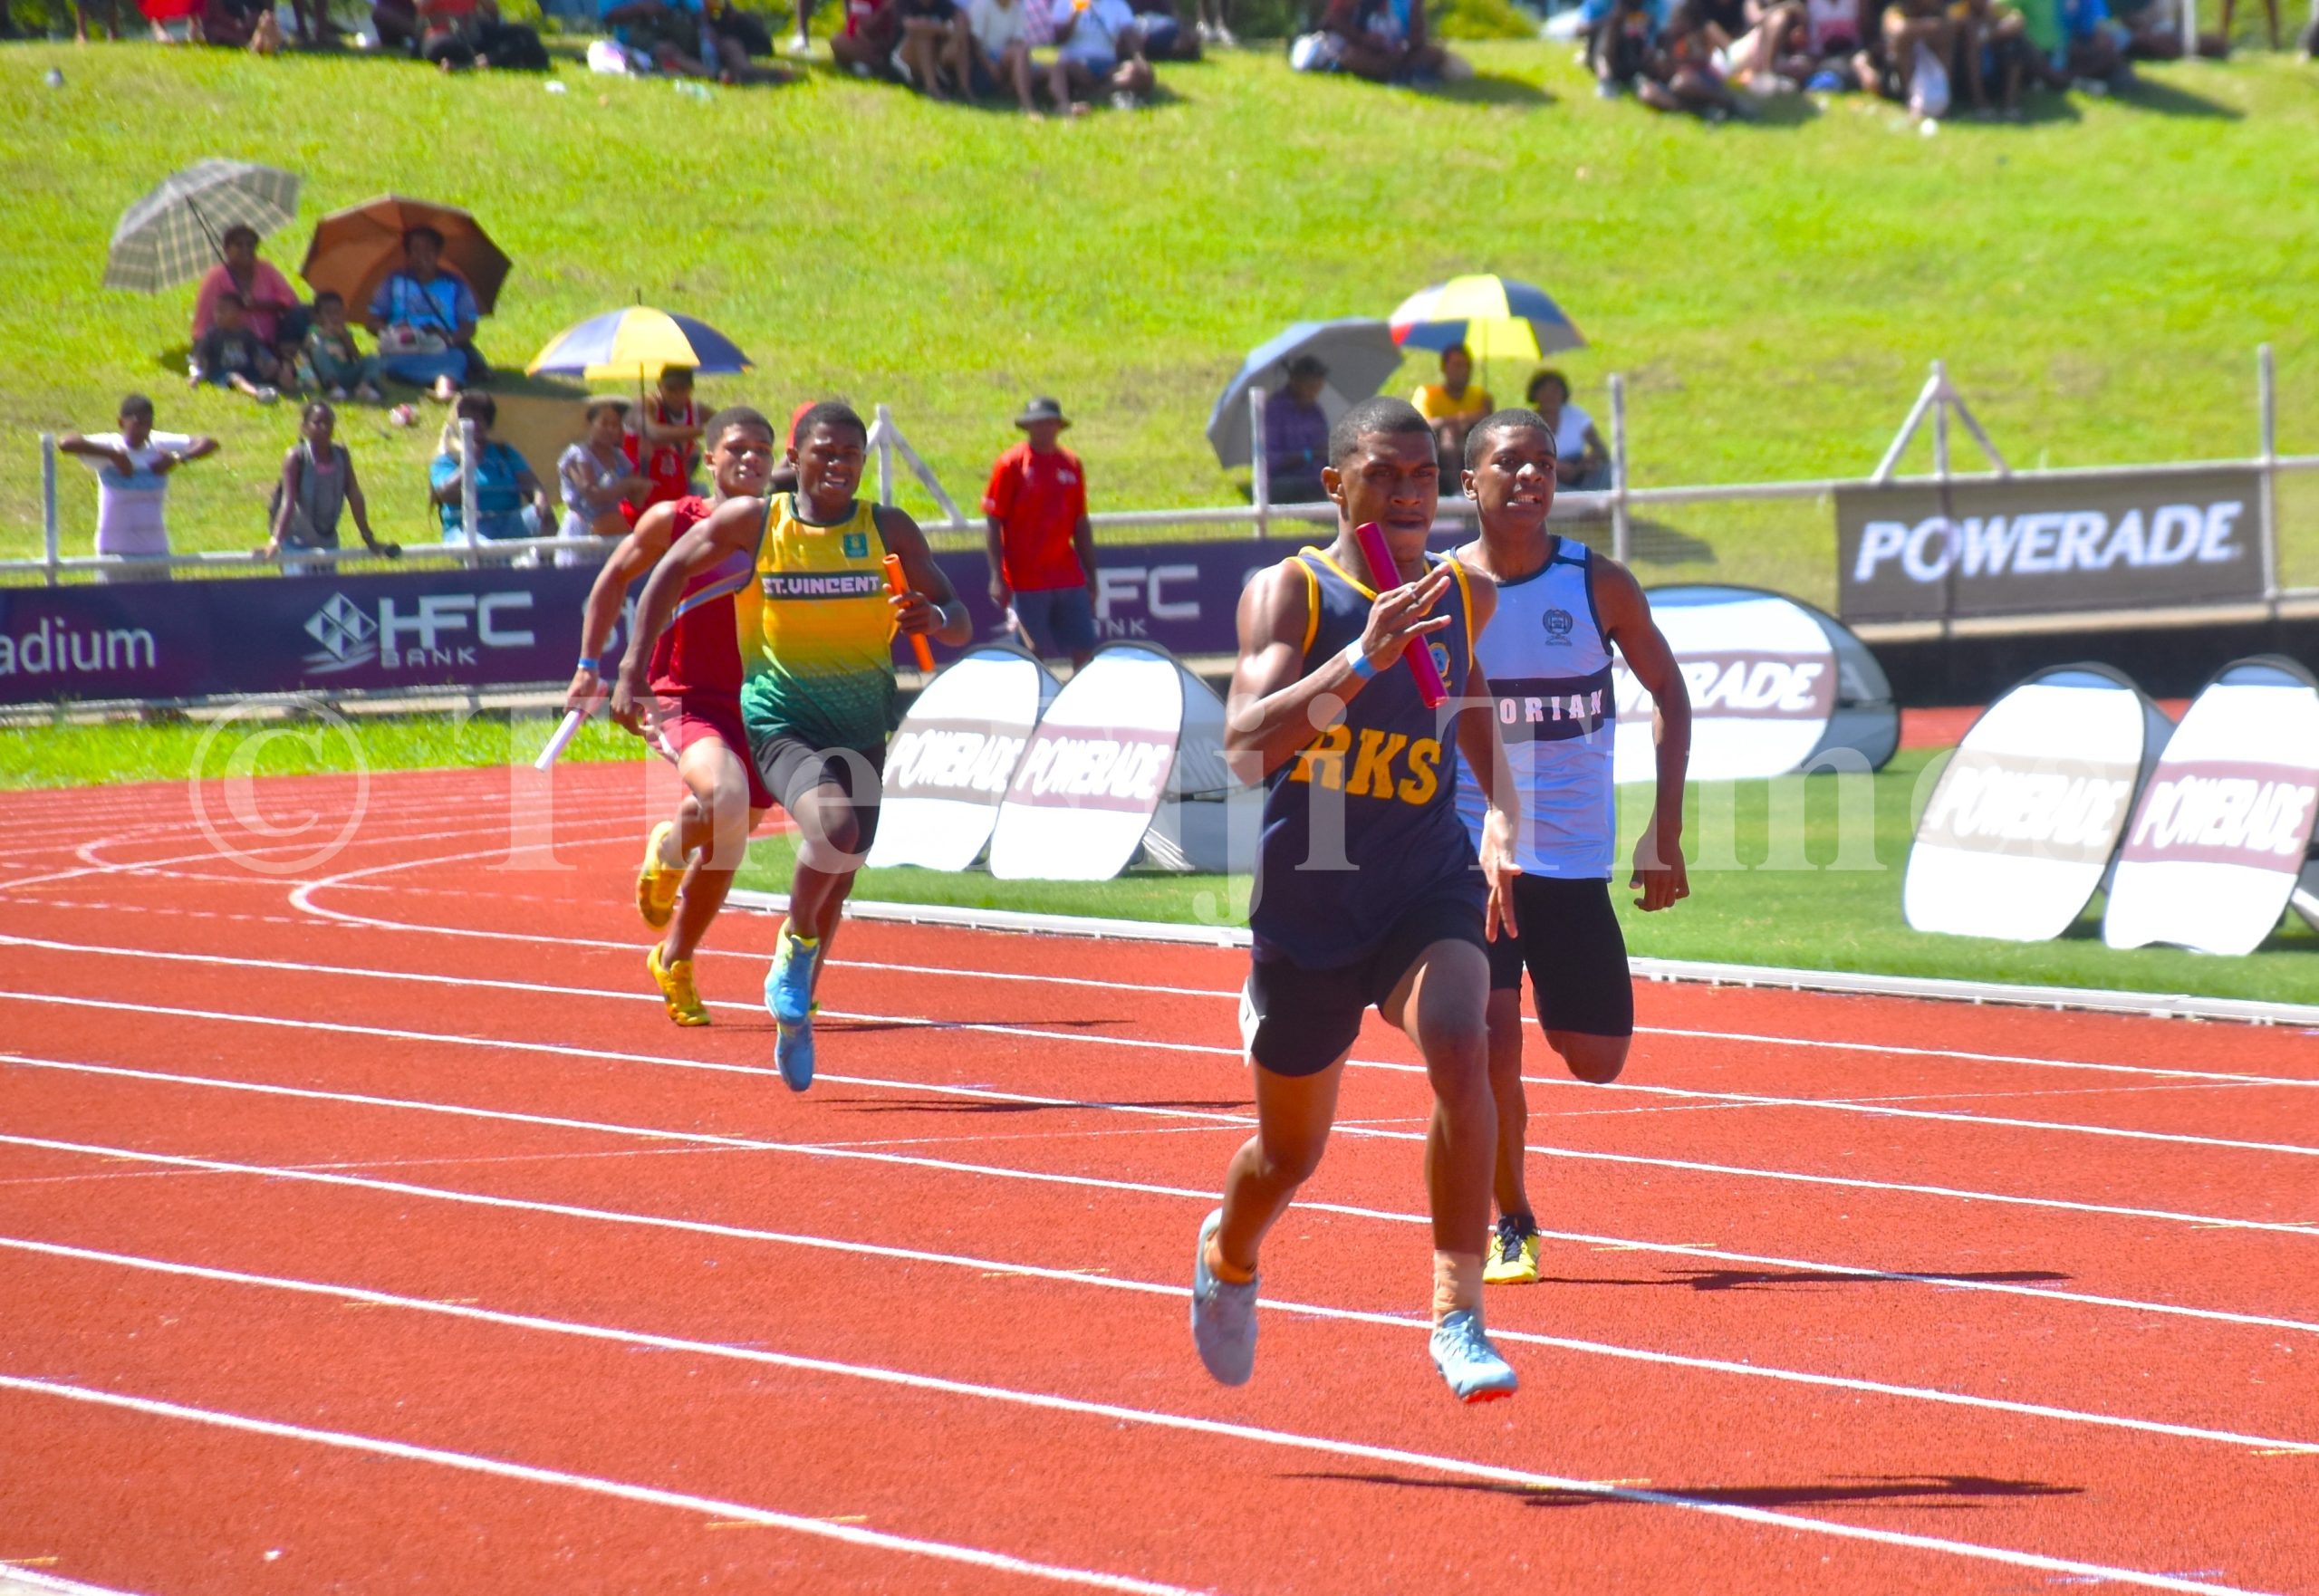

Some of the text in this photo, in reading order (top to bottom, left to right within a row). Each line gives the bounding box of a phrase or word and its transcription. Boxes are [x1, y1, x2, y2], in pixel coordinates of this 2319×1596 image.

[1854, 501, 2244, 582] POWERADE
[379, 591, 534, 650] HFC
[1095, 564, 1200, 620] FC
[0, 615, 156, 675] adium
[380, 646, 477, 668] BANK
[1092, 617, 1149, 638] NK
[882, 728, 1026, 793] POWERADE
[1015, 736, 1171, 801] POWERADE
[1290, 724, 1441, 806] RKS
[1928, 765, 2131, 847] POWERADE
[2132, 774, 2317, 855] POWERADE
